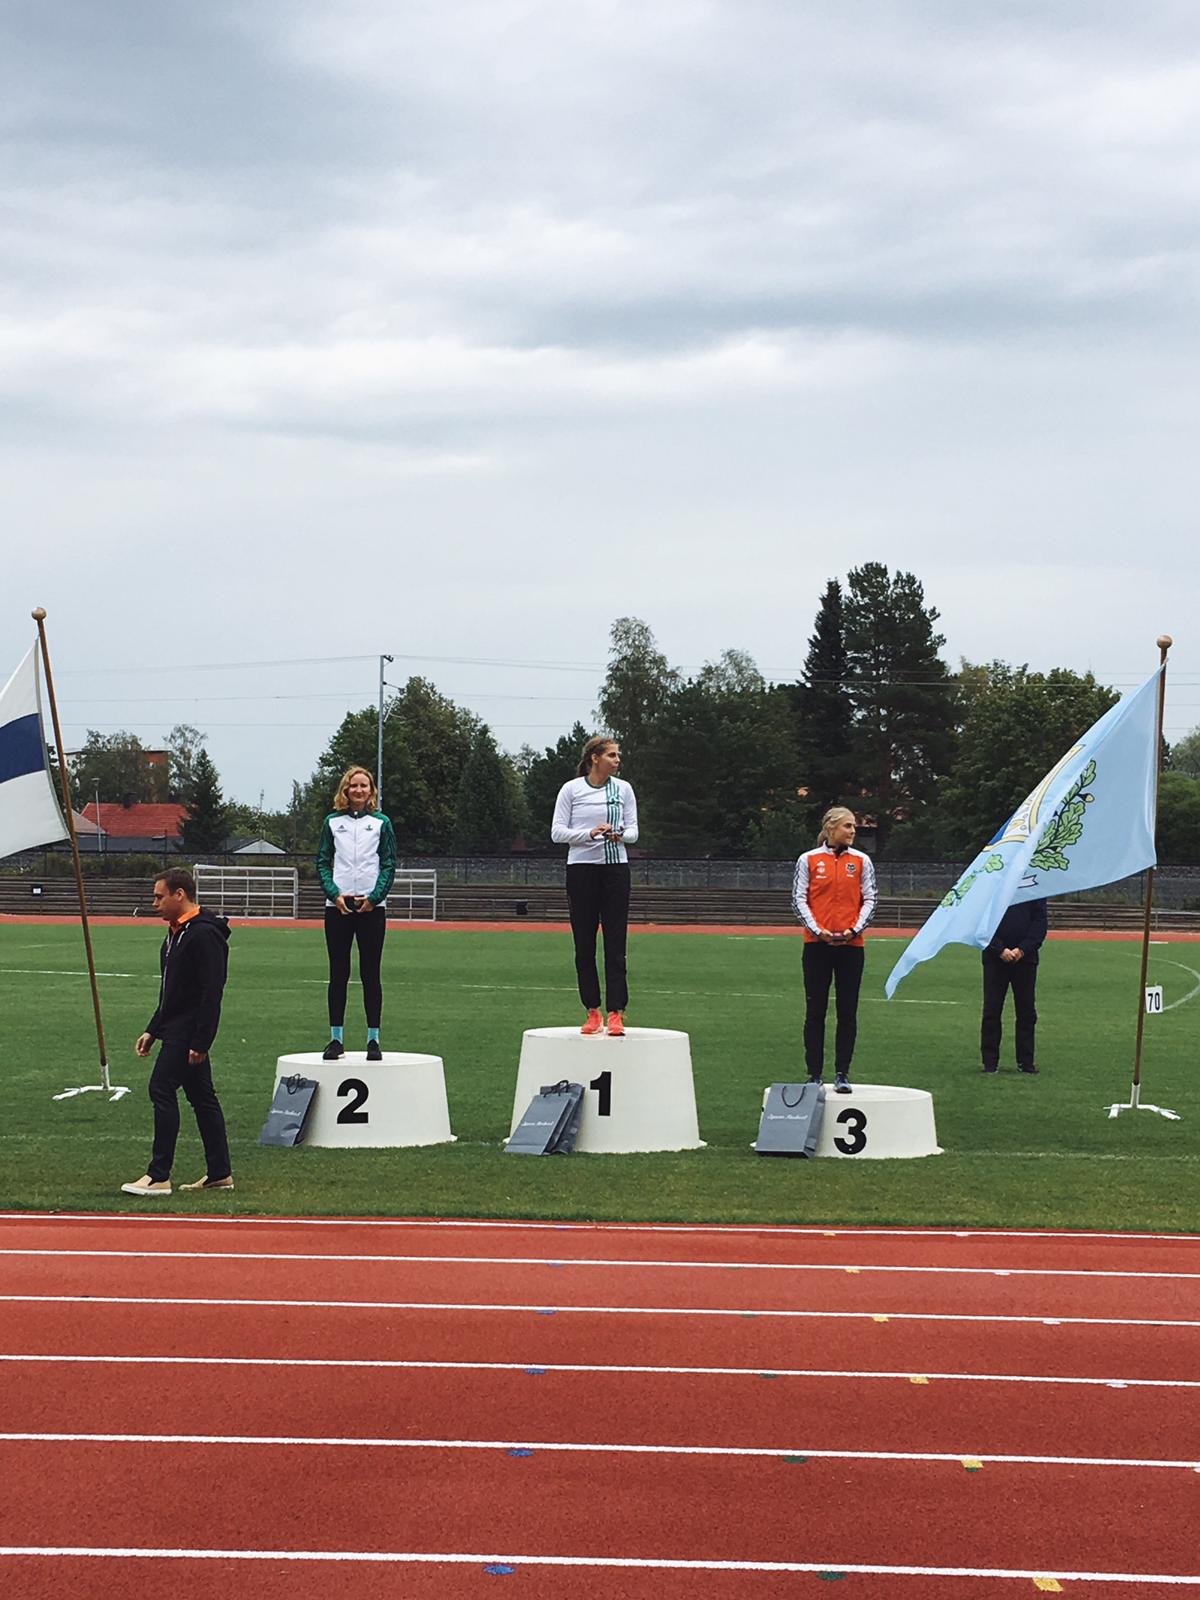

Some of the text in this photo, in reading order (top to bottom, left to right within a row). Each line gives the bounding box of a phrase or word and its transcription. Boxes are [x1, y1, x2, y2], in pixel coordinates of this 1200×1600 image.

[1147, 992, 1160, 1011] 70
[336, 1078, 369, 1124] 2
[590, 1071, 612, 1116] 1
[834, 1108, 867, 1155] 3
